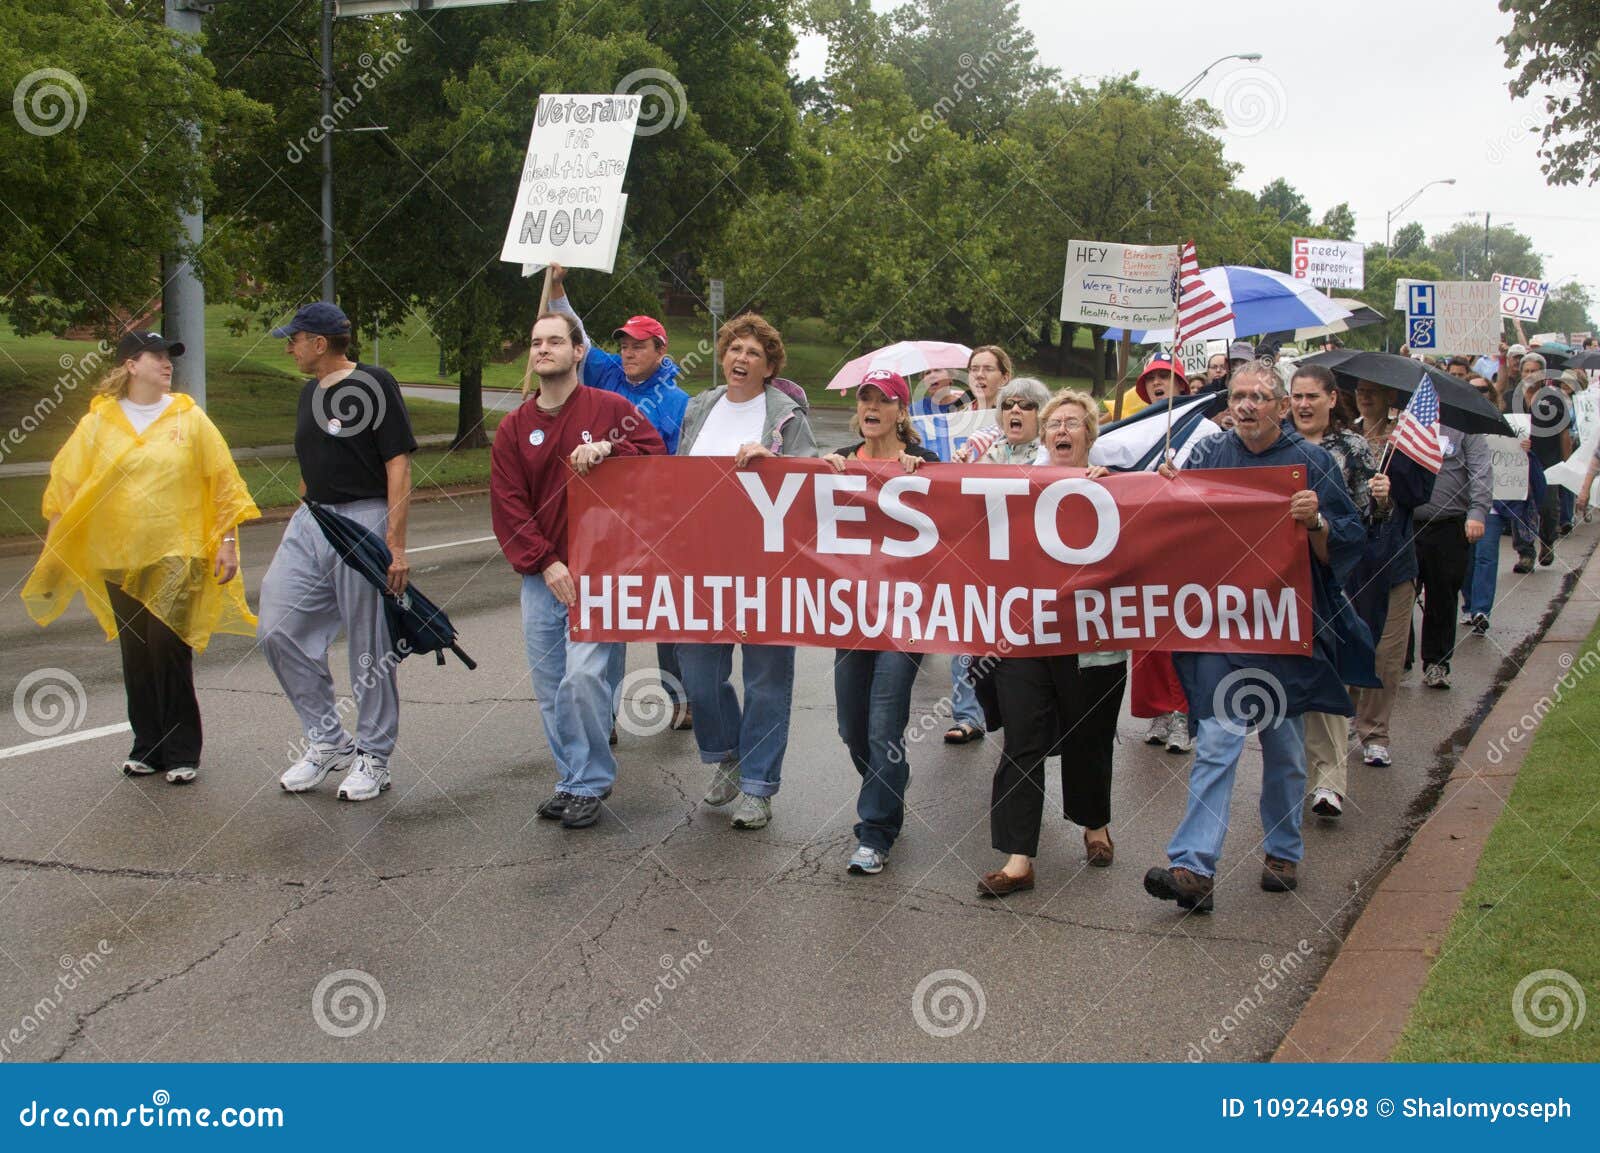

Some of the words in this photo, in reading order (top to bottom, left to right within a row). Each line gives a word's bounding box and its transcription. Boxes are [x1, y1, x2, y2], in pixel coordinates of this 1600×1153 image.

[537, 96, 638, 127] Veterans
[518, 207, 604, 247] NOW
[1076, 247, 1108, 263] HEY
[1118, 282, 1143, 295] Tired
[1080, 306, 1110, 318] Health
[1503, 297, 1537, 316] OW
[735, 471, 940, 558] YES
[961, 477, 1121, 565] TO
[579, 575, 766, 632] HEALTH
[780, 577, 1061, 645] INSURANCE
[1074, 583, 1300, 641] REFORM
